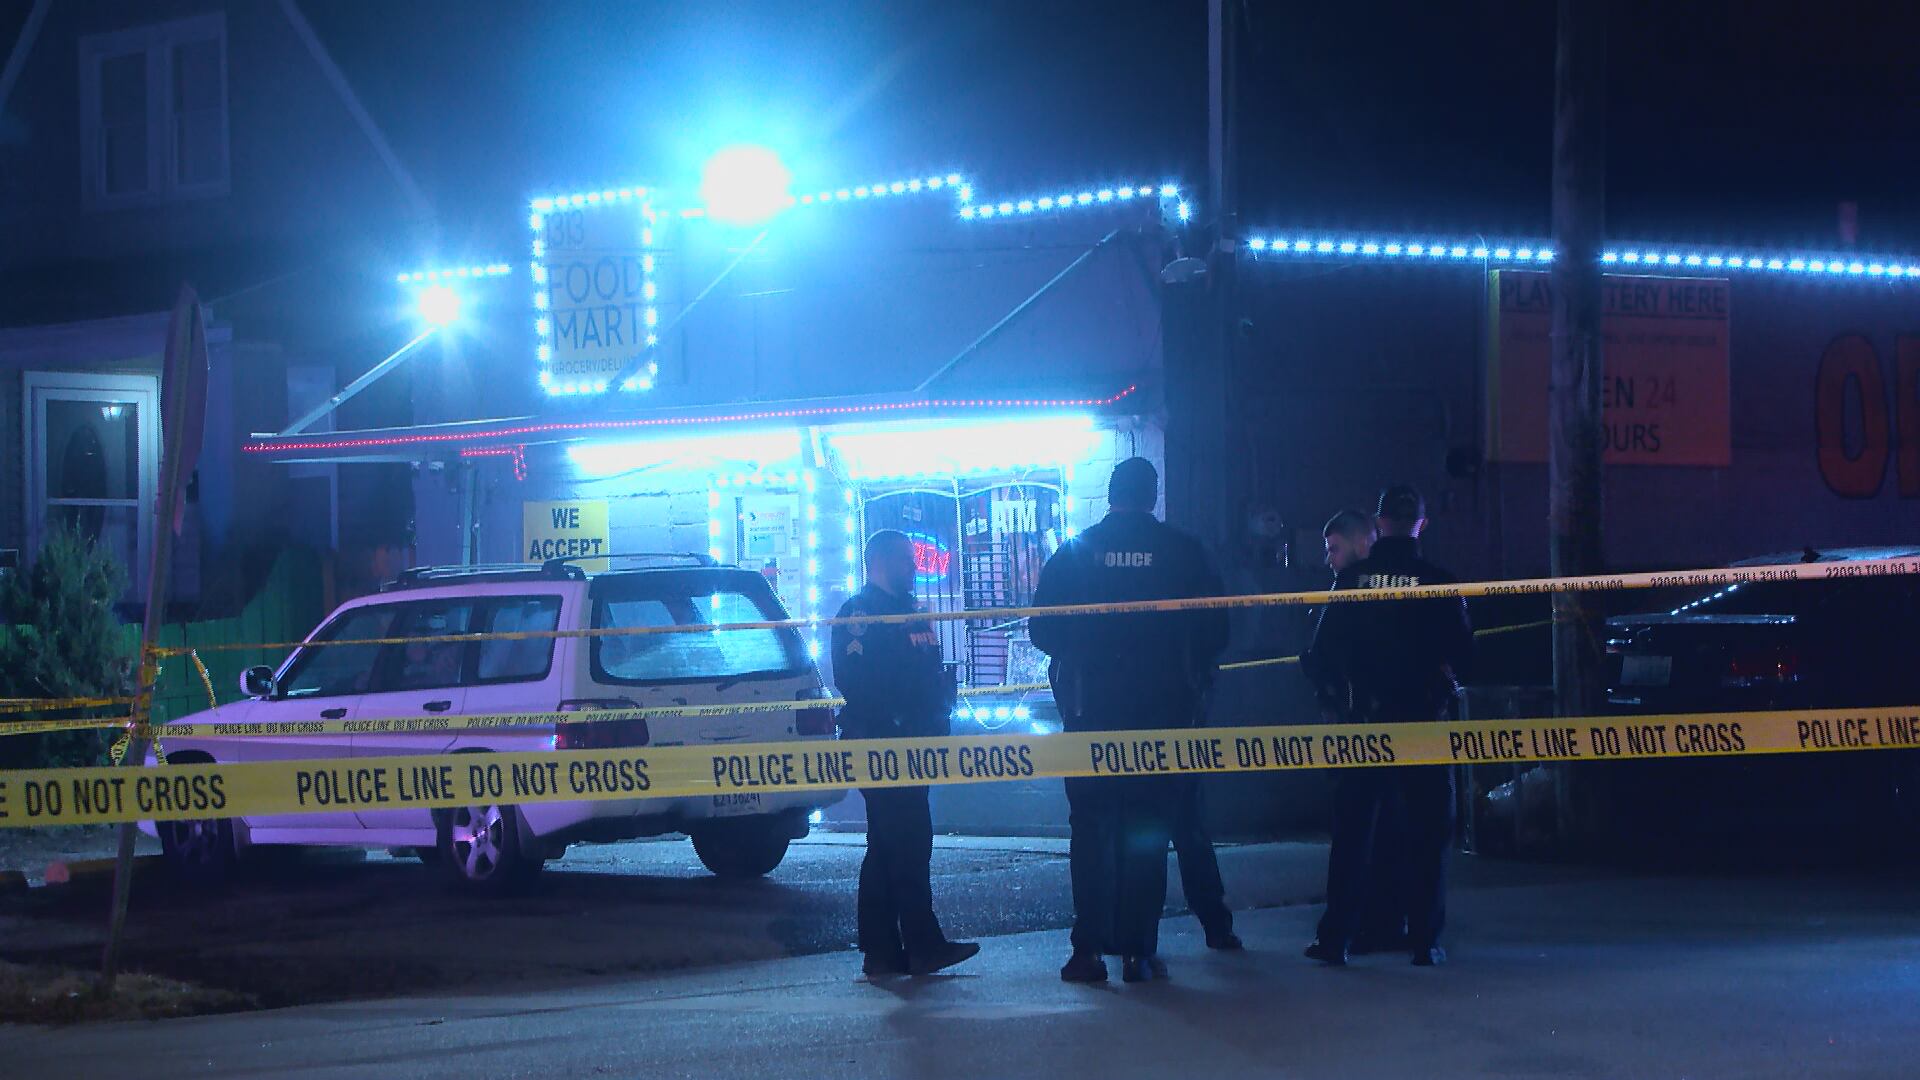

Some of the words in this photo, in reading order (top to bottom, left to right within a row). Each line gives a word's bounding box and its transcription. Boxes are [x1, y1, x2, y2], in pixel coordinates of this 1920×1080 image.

[550, 256, 644, 304] FOOD
[1603, 284, 1659, 310] TERY
[1668, 285, 1725, 313] HERE
[553, 304, 639, 350] MART
[1646, 375, 1676, 408] 24
[551, 508, 579, 528] WE
[992, 500, 1037, 532] ATM
[530, 539, 602, 559] ACCEPT
[1096, 551, 1152, 567] OLICE
[214, 723, 242, 734] POLICE
[244, 723, 262, 734] LINE
[266, 723, 277, 733] DO
[280, 723, 296, 733] NOT
[298, 722, 324, 732] CROSS
[344, 720, 372, 731] POLICE
[373, 720, 390, 730] LINE
[393, 720, 405, 730] DO
[407, 719, 423, 729] NOT
[424, 719, 449, 729] CROSS
[467, 717, 494, 727] POLICE
[495, 717, 513, 726] LINE
[1797, 719, 1872, 749] POLICE
[1876, 716, 1920, 746] LINE
[1091, 740, 1167, 773] POLICE
[1175, 738, 1226, 770] LINE
[1235, 737, 1266, 768] DO
[1272, 735, 1314, 767] NOT
[1322, 733, 1396, 765] CROSS
[1450, 730, 1526, 760] POLICE
[1532, 728, 1581, 758] LINE
[1590, 727, 1621, 757] DO
[1627, 725, 1668, 755] NOT
[1675, 722, 1746, 753] CROSS
[297, 768, 389, 805] POLICE
[397, 766, 455, 801] LINE
[469, 765, 500, 799] DO
[512, 761, 563, 796] NOT
[569, 759, 651, 793] CROSS
[713, 754, 797, 787] POLICE
[804, 751, 856, 784] LINE
[868, 750, 900, 782] DO
[908, 747, 950, 779] NOT
[959, 744, 1034, 778] CROSS
[25, 780, 63, 816] DO
[73, 778, 125, 815] NOT
[136, 773, 227, 811] CROSS
